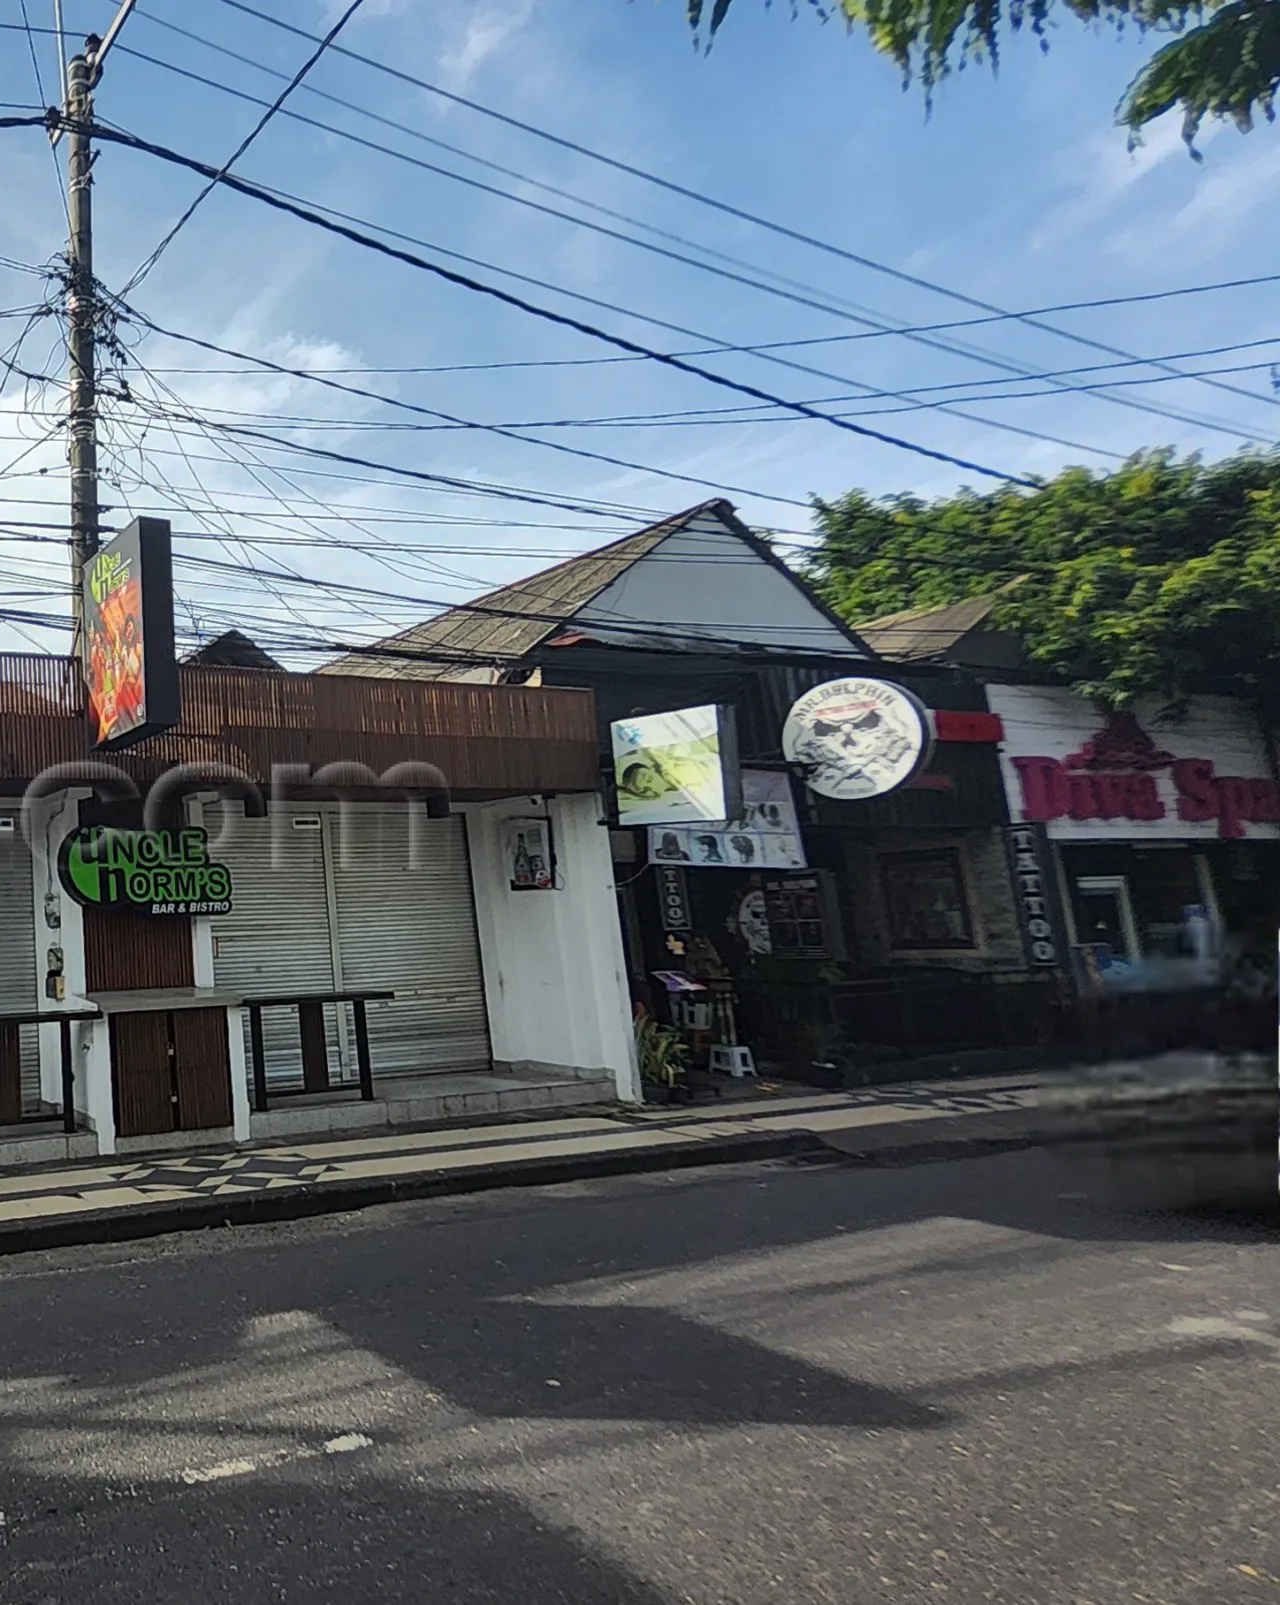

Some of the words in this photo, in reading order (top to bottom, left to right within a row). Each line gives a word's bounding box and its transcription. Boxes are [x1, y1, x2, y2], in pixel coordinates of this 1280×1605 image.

[151, 903, 176, 914] BAR
[178, 904, 187, 914] &
[189, 901, 230, 913] BISTRO
[1011, 829, 1056, 960] TATTOO
